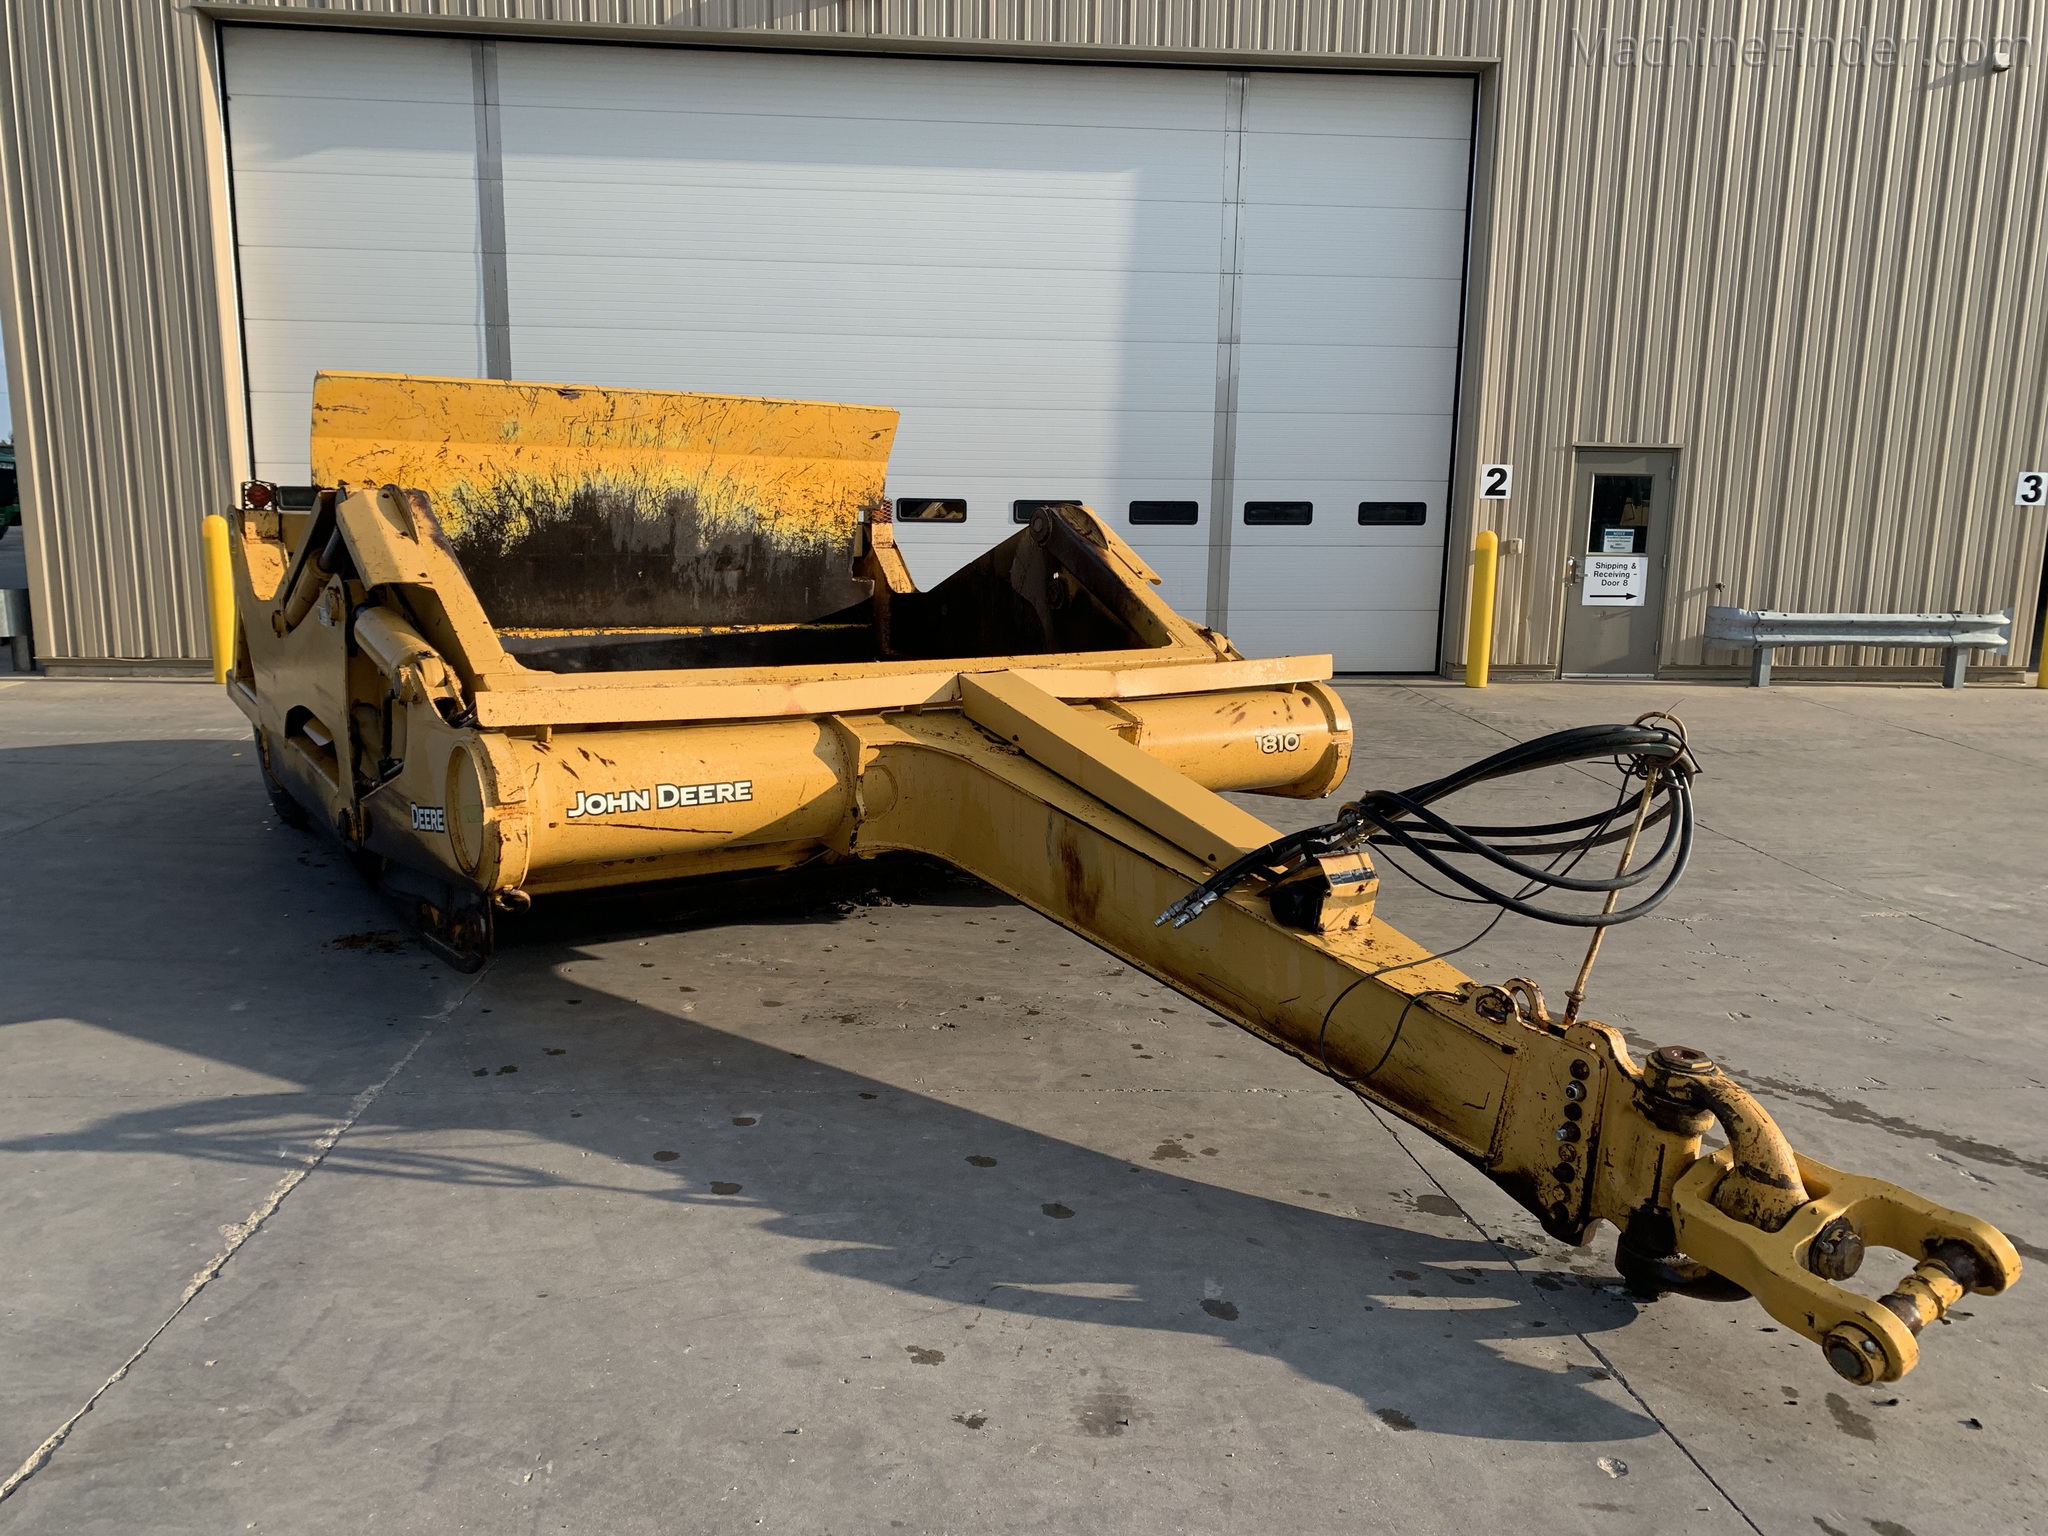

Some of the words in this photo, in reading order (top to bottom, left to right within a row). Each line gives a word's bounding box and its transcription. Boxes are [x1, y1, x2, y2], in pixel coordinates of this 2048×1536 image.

[1485, 467, 1508, 496] 2
[2021, 474, 2043, 503] 3
[1593, 570, 1630, 579] Receiving
[1595, 561, 1628, 570] Shipping
[1255, 733, 1301, 754] 1810
[566, 789, 651, 818] JOHN
[656, 780, 753, 809] DEERE
[410, 802, 445, 833] DEERE
